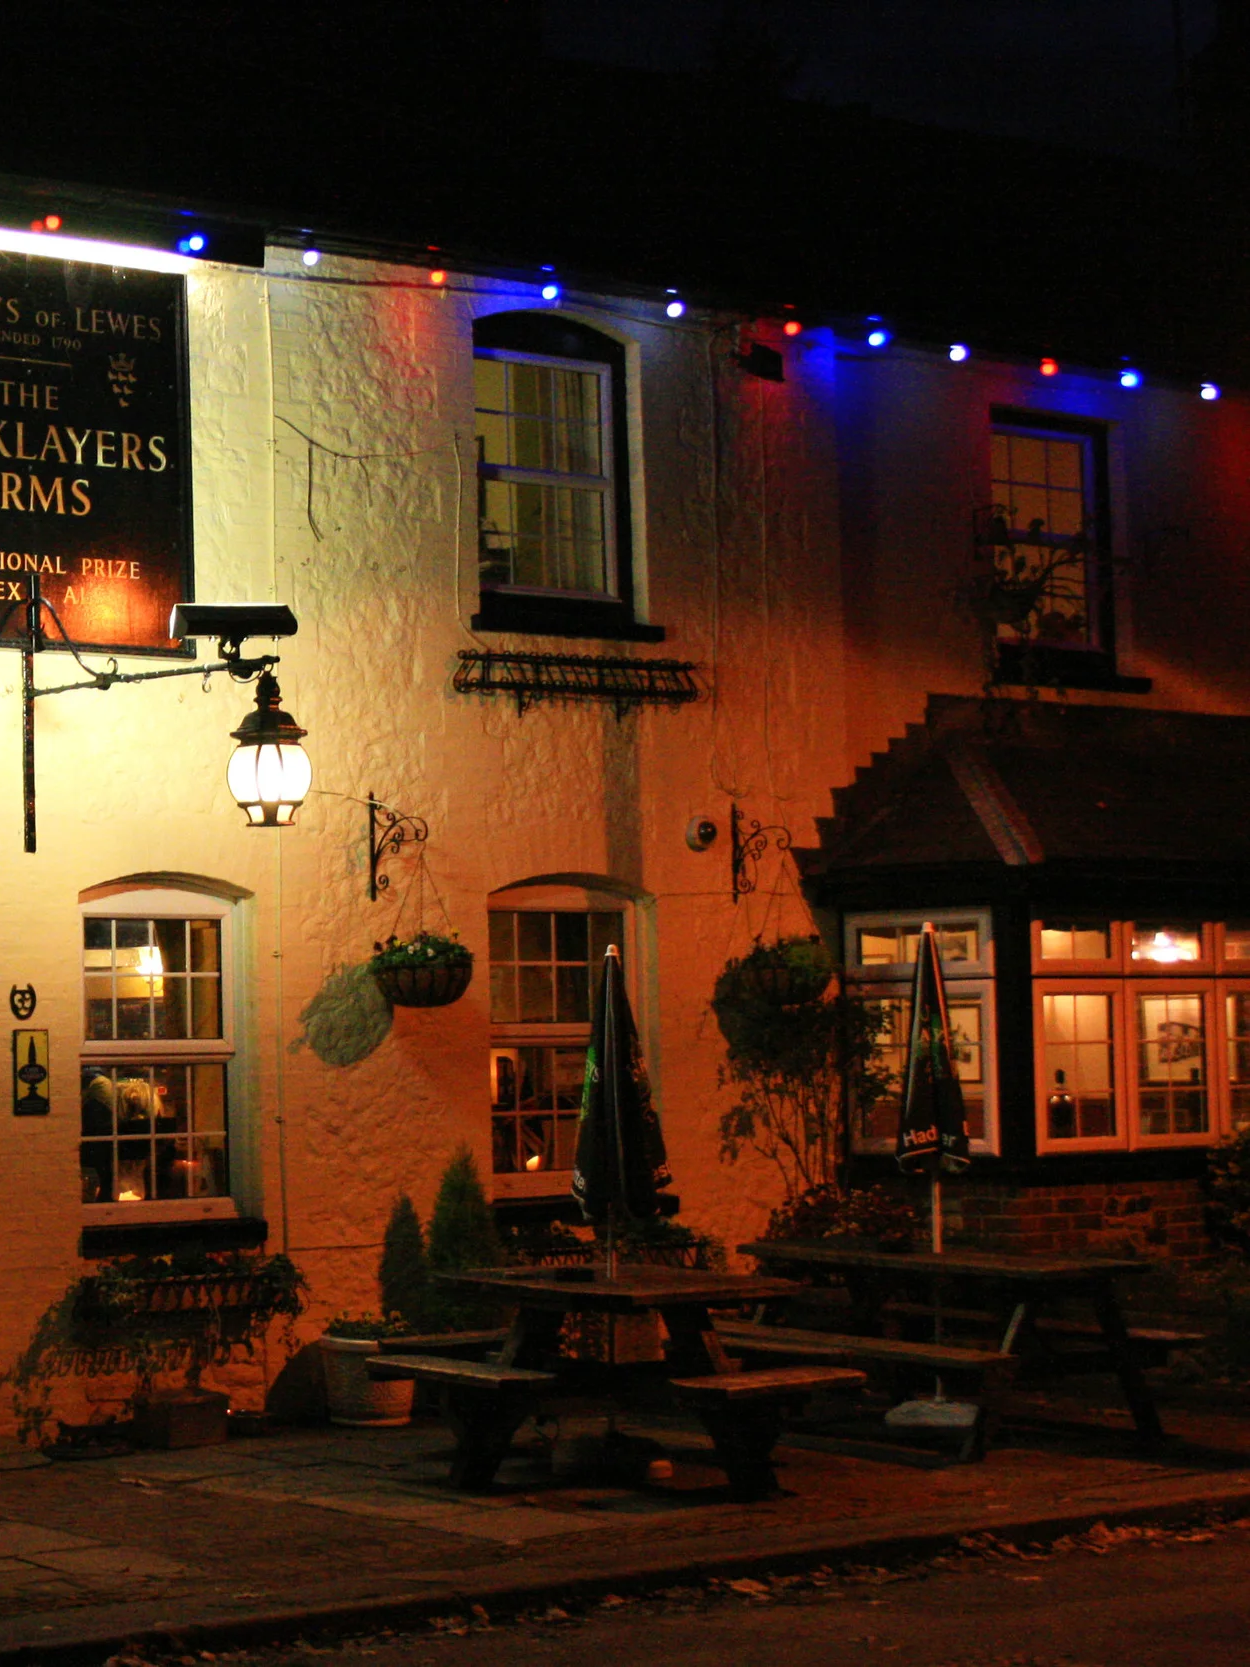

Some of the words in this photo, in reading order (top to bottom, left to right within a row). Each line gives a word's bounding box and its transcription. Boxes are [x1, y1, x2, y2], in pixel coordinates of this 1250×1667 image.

[36, 311, 61, 328] OF
[76, 307, 161, 342] LEWES
[52, 336, 82, 351] 1790
[82, 558, 140, 580] PRIZE
